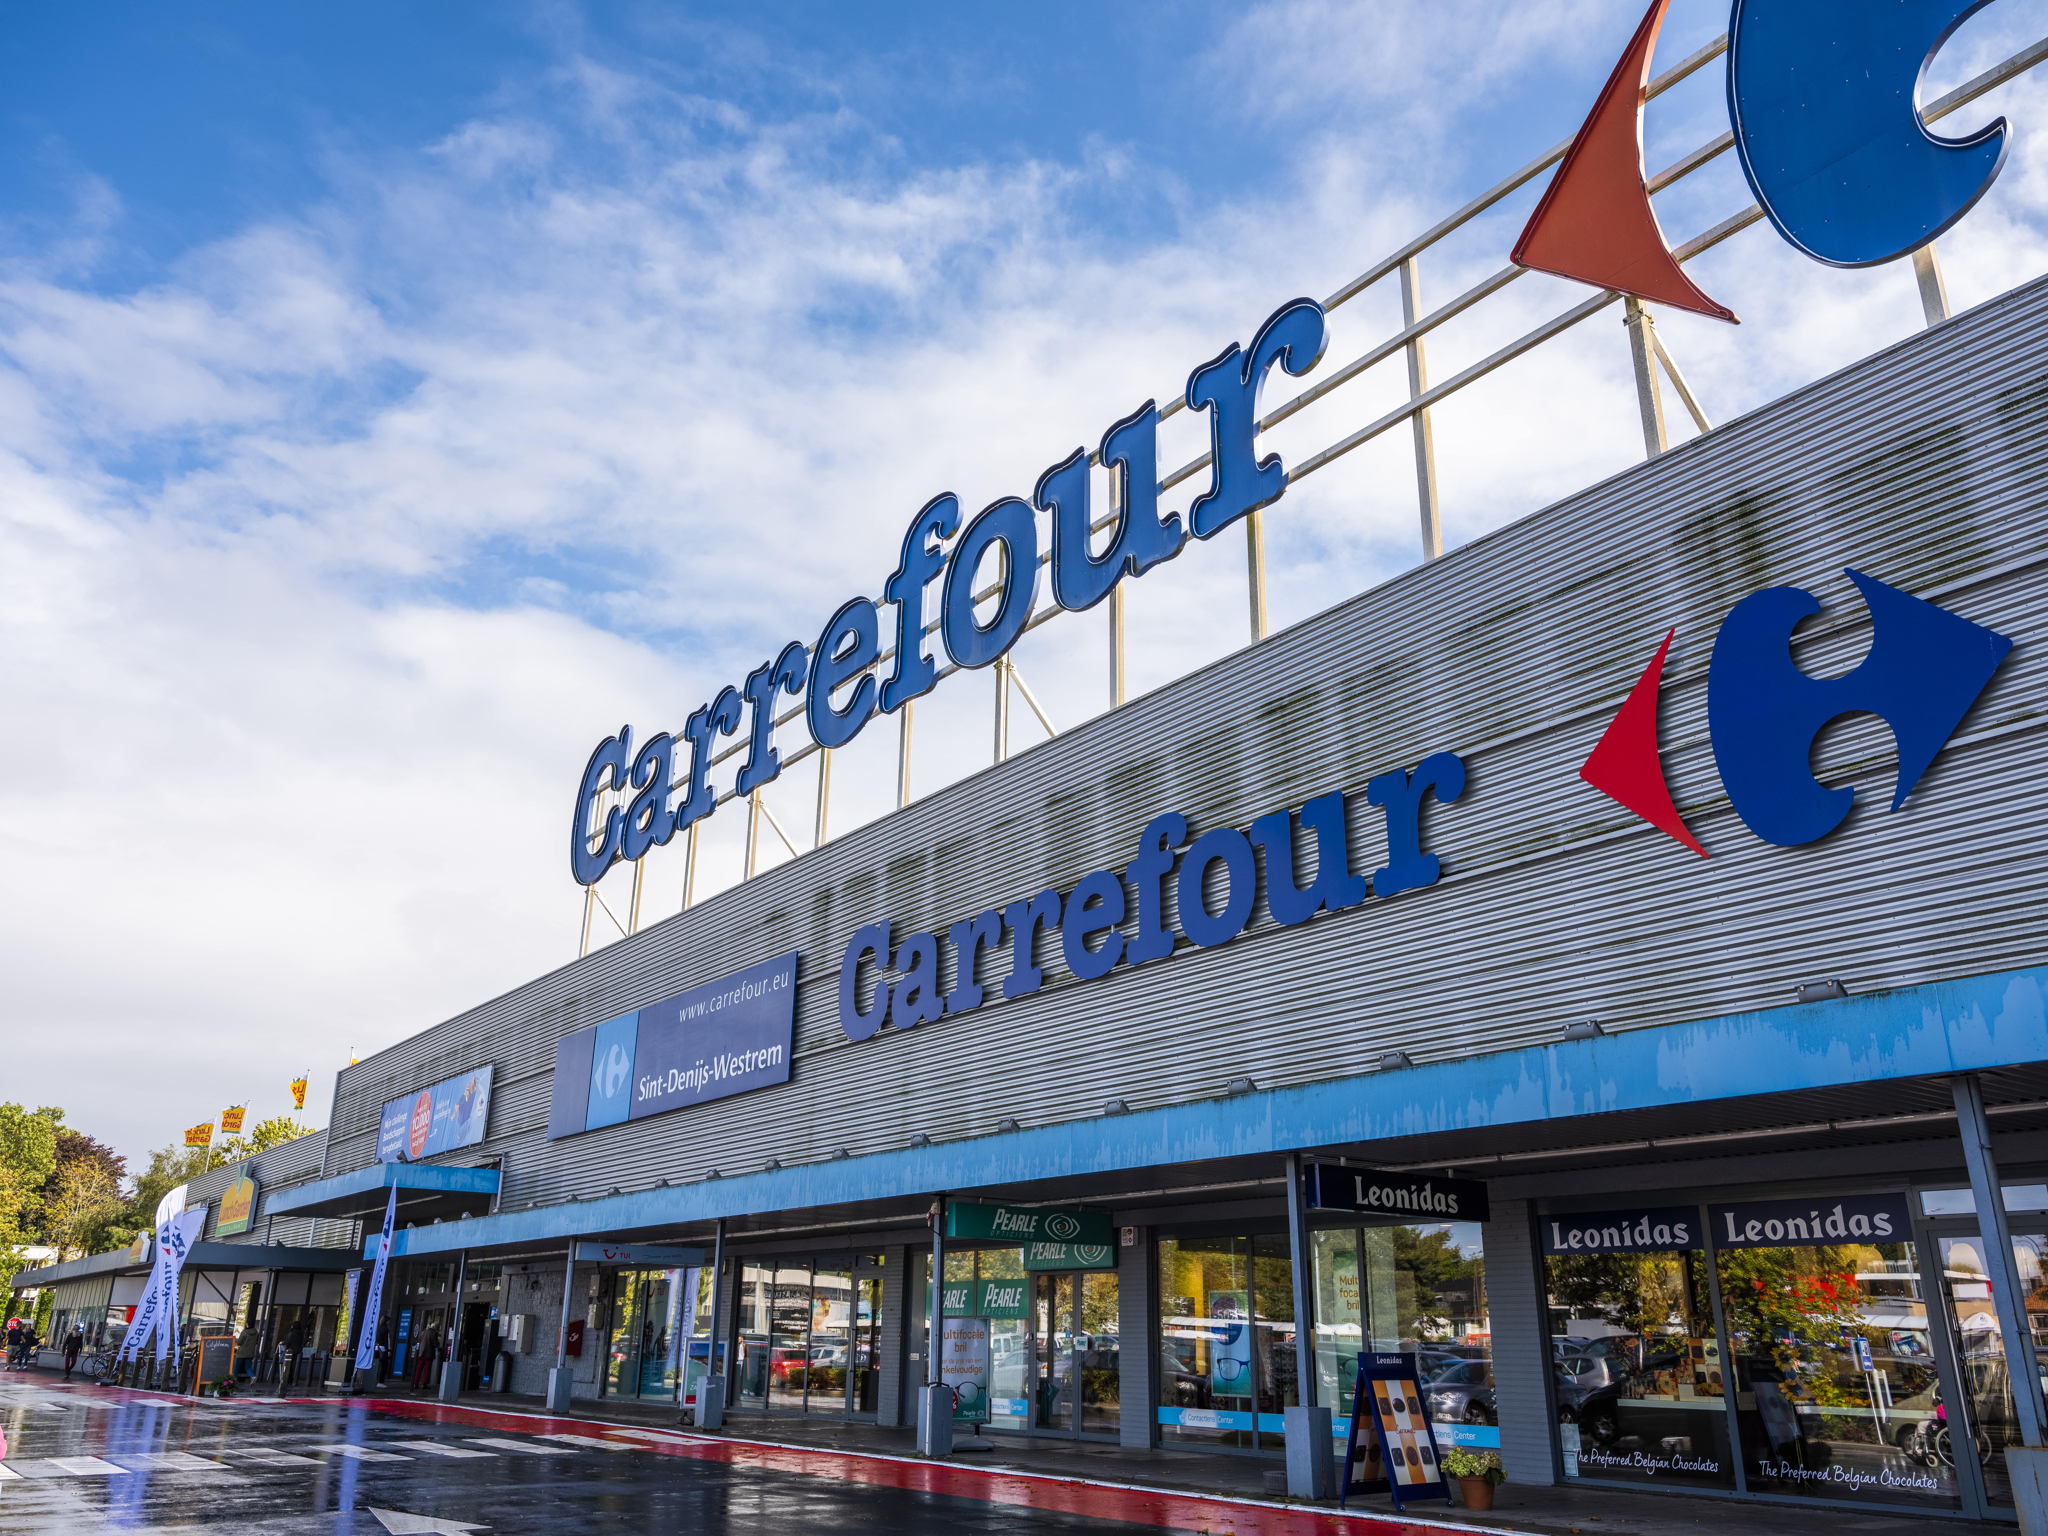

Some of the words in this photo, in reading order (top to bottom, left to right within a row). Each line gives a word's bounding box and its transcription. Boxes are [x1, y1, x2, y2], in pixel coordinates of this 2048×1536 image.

[571, 297, 1330, 887] Carrefour
[838, 751, 1466, 1042] Carrefour
[679, 970, 790, 1023] www.carrefour.eu
[638, 1044, 783, 1102] Sint-Denijs-Westrem
[1354, 1175, 1459, 1214] Leonidas
[1551, 1215, 1690, 1250] Leonidas
[1724, 1204, 1894, 1243] Leonidas
[1339, 1275, 1359, 1286] Mult
[127, 1286, 158, 1349] Carrefo
[942, 1328, 985, 1340] ultifocale
[941, 1365, 983, 1377] nkelvoudige
[1376, 1356, 1403, 1364] Leonidas
[1590, 1452, 1633, 1468] Preferred
[1634, 1452, 1670, 1475] Belgian
[1672, 1454, 1720, 1473] Chocolates
[1759, 1460, 1778, 1478] The
[1780, 1462, 1832, 1482] Preferred
[1833, 1464, 1878, 1491] Belgian
[1880, 1468, 1938, 1490] Chocolates
